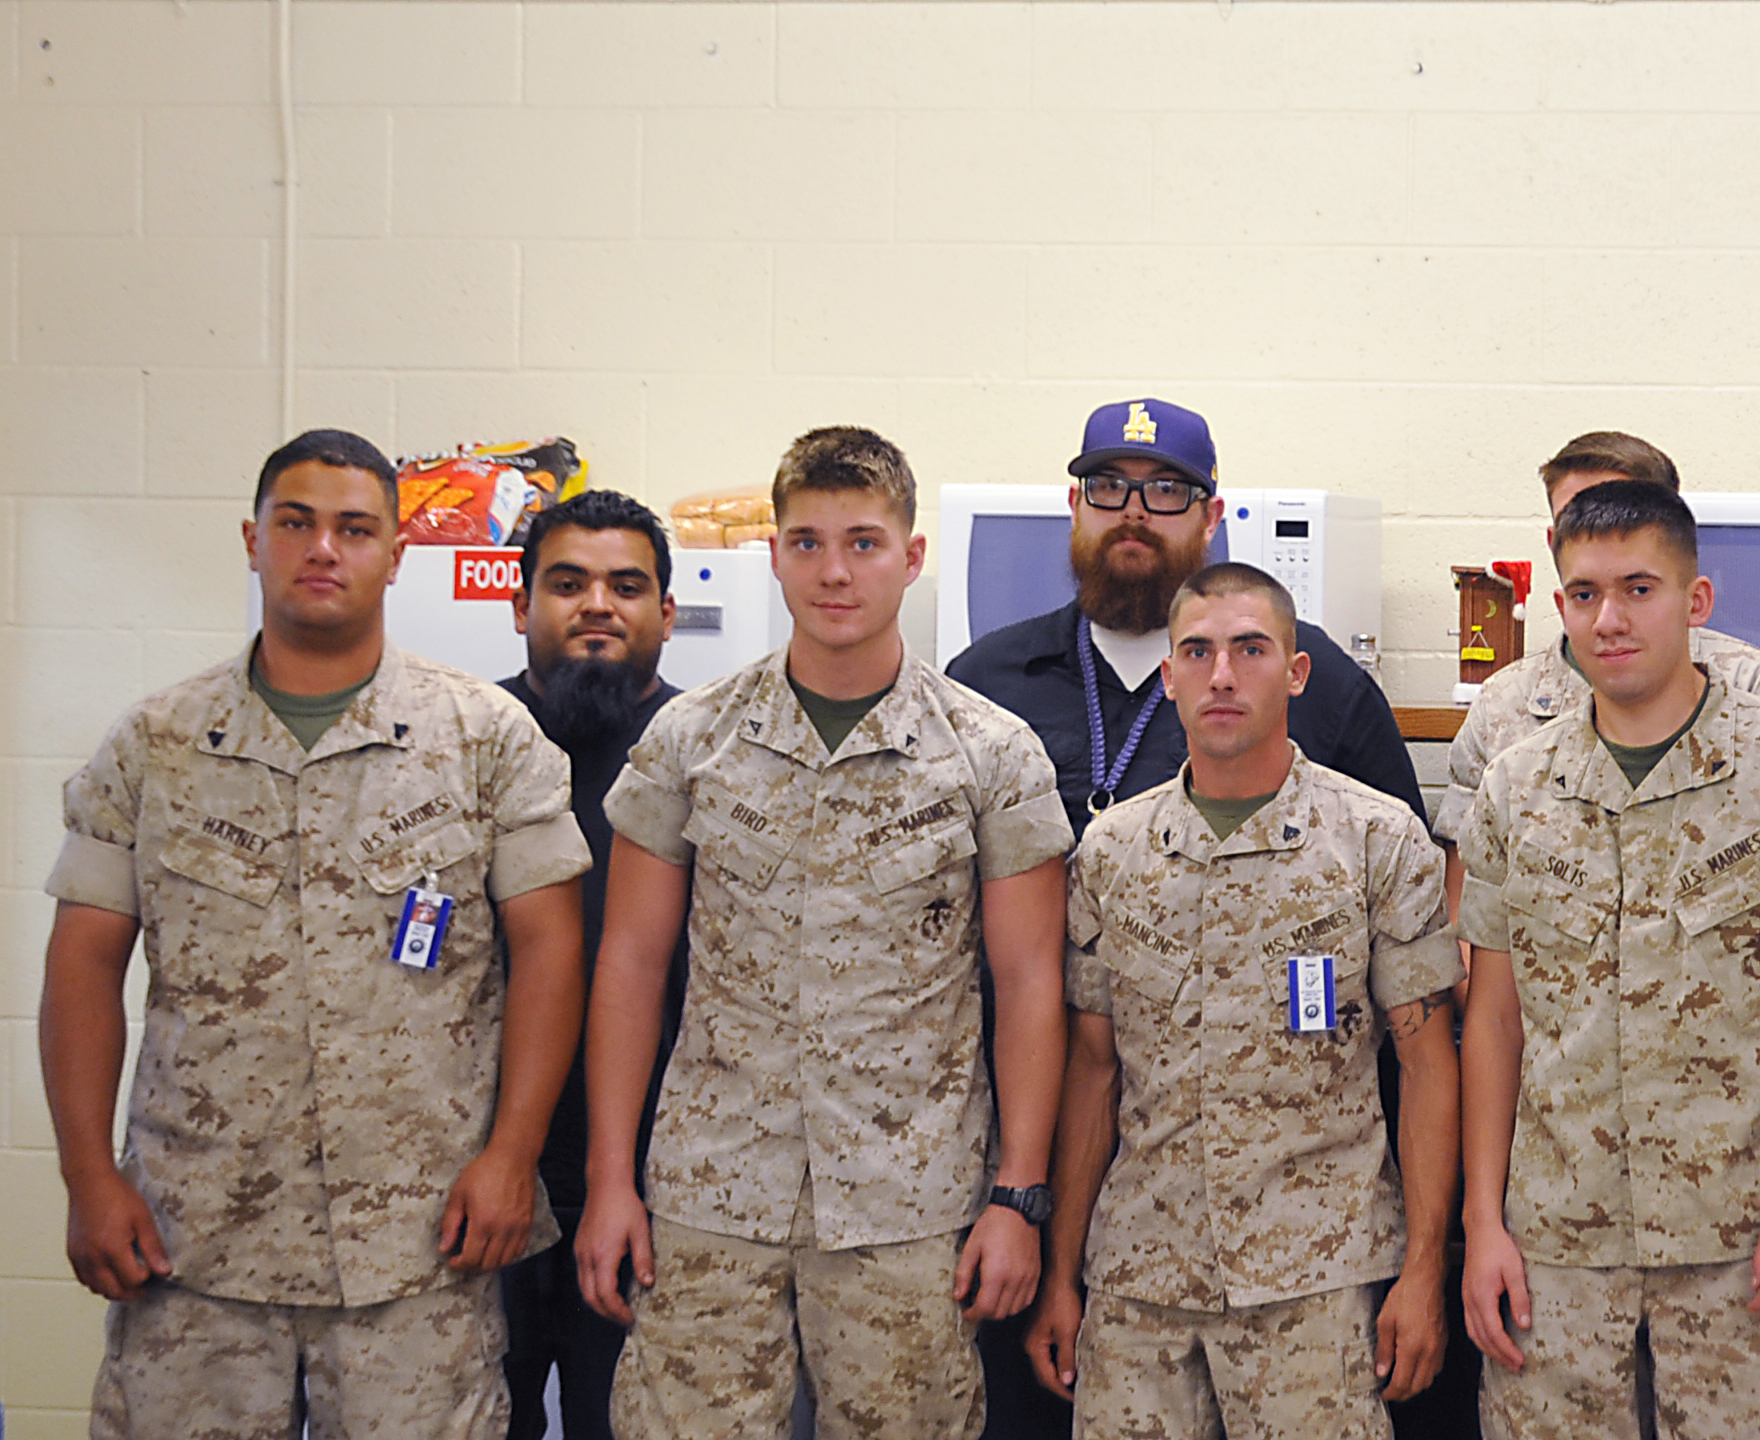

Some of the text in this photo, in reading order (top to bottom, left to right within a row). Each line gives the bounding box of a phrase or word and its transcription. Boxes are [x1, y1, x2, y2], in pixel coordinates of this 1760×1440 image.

[1123, 402, 1157, 444] LA
[460, 558, 524, 590] FOOD
[389, 794, 452, 837] MARINES
[730, 802, 768, 834] BIRD
[898, 797, 956, 835] MARINES
[203, 815, 273, 855] HARNEY
[1544, 855, 1588, 888] SOLIS
[1290, 908, 1351, 946] MARINES
